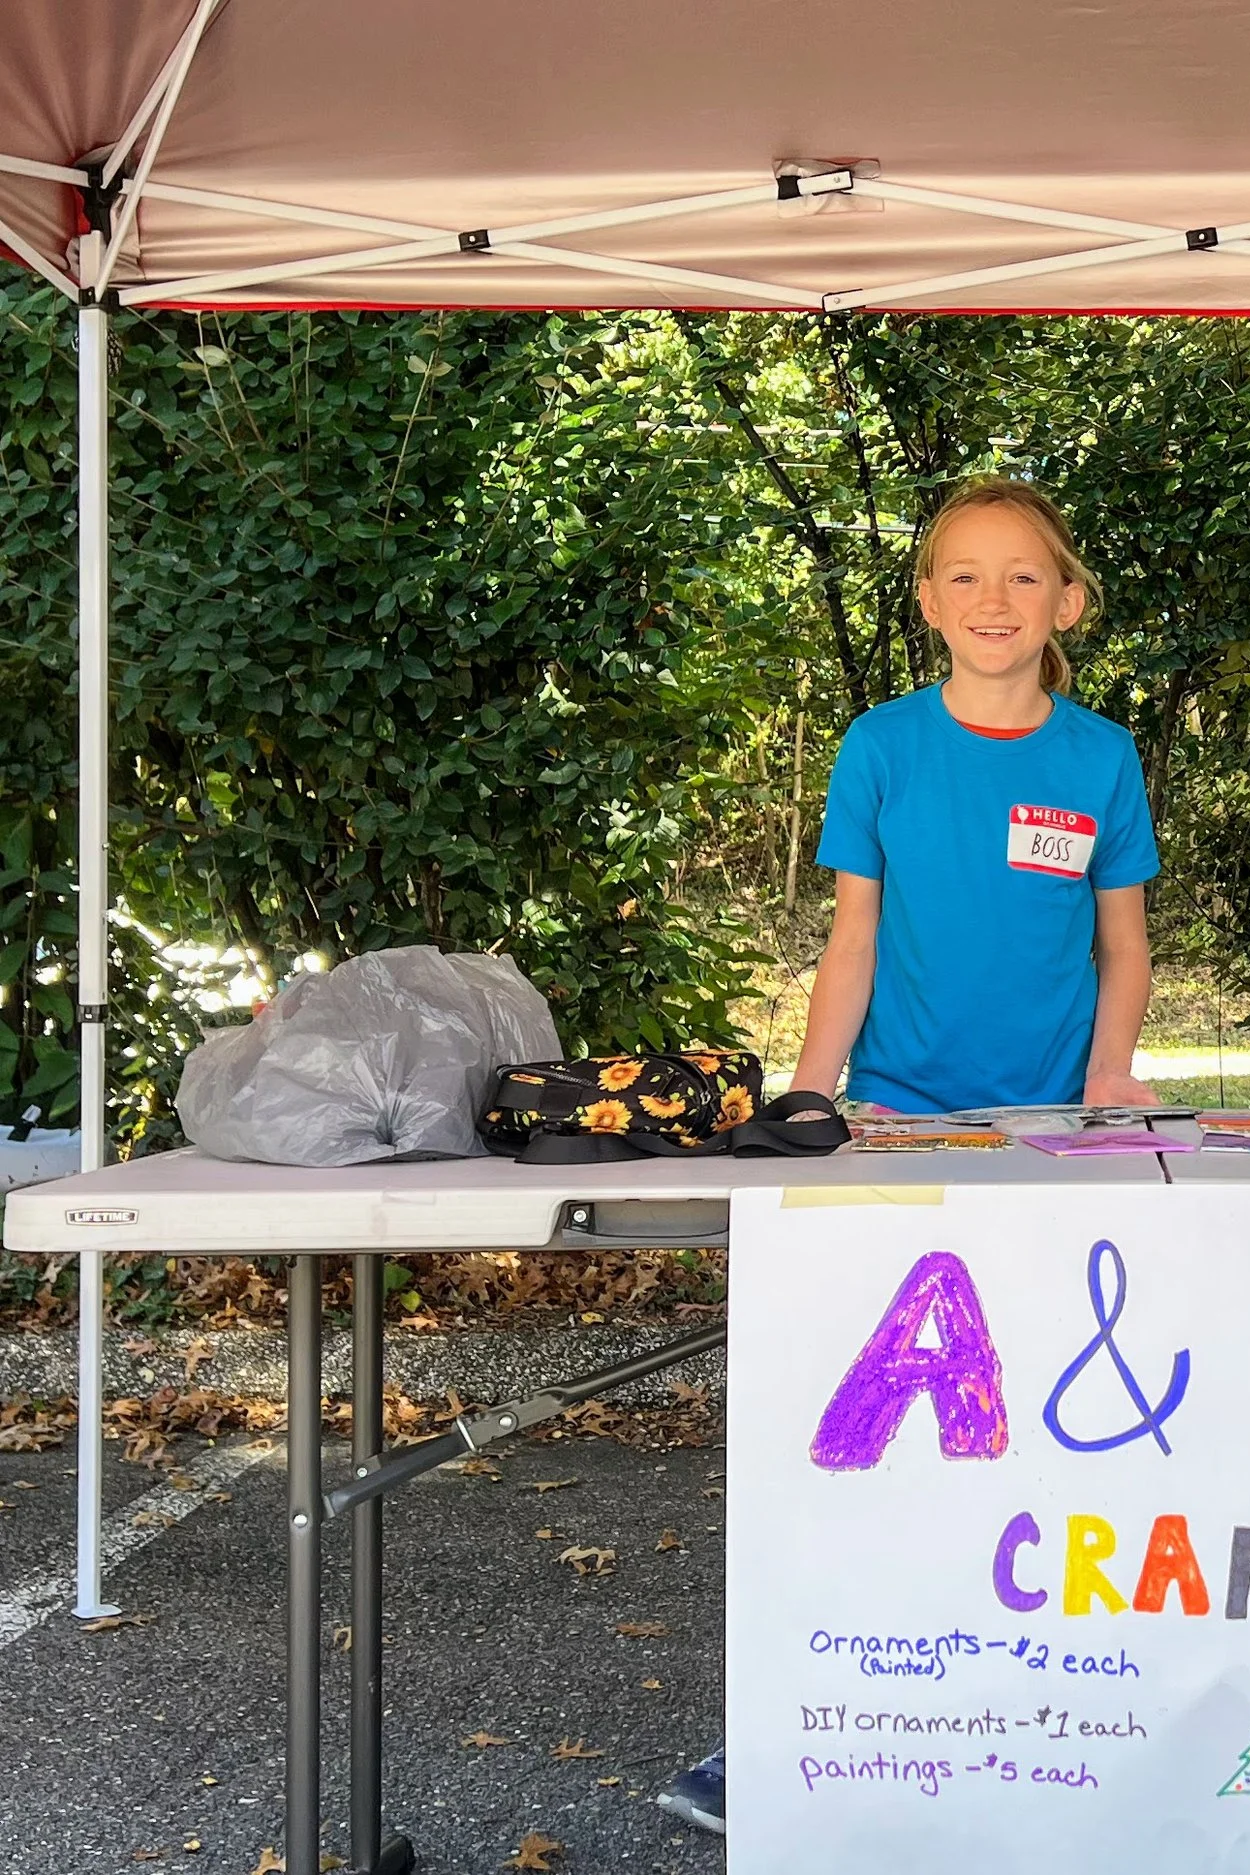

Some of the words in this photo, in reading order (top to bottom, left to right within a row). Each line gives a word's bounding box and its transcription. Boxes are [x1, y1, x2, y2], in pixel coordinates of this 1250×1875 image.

[1033, 808, 1077, 825] HELLO
[1031, 832, 1074, 862] BOSS
[74, 1212, 130, 1222] LIFETIME
[809, 1250, 1009, 1472] A
[1042, 1239, 1190, 1457] &
[1062, 1648, 1140, 1678] each
[800, 1704, 846, 1733] DIY
[855, 1708, 1006, 1736] ornaments
[1078, 1711, 1147, 1740] each
[799, 1752, 953, 1796] paintings
[1031, 1762, 1098, 1790] each
